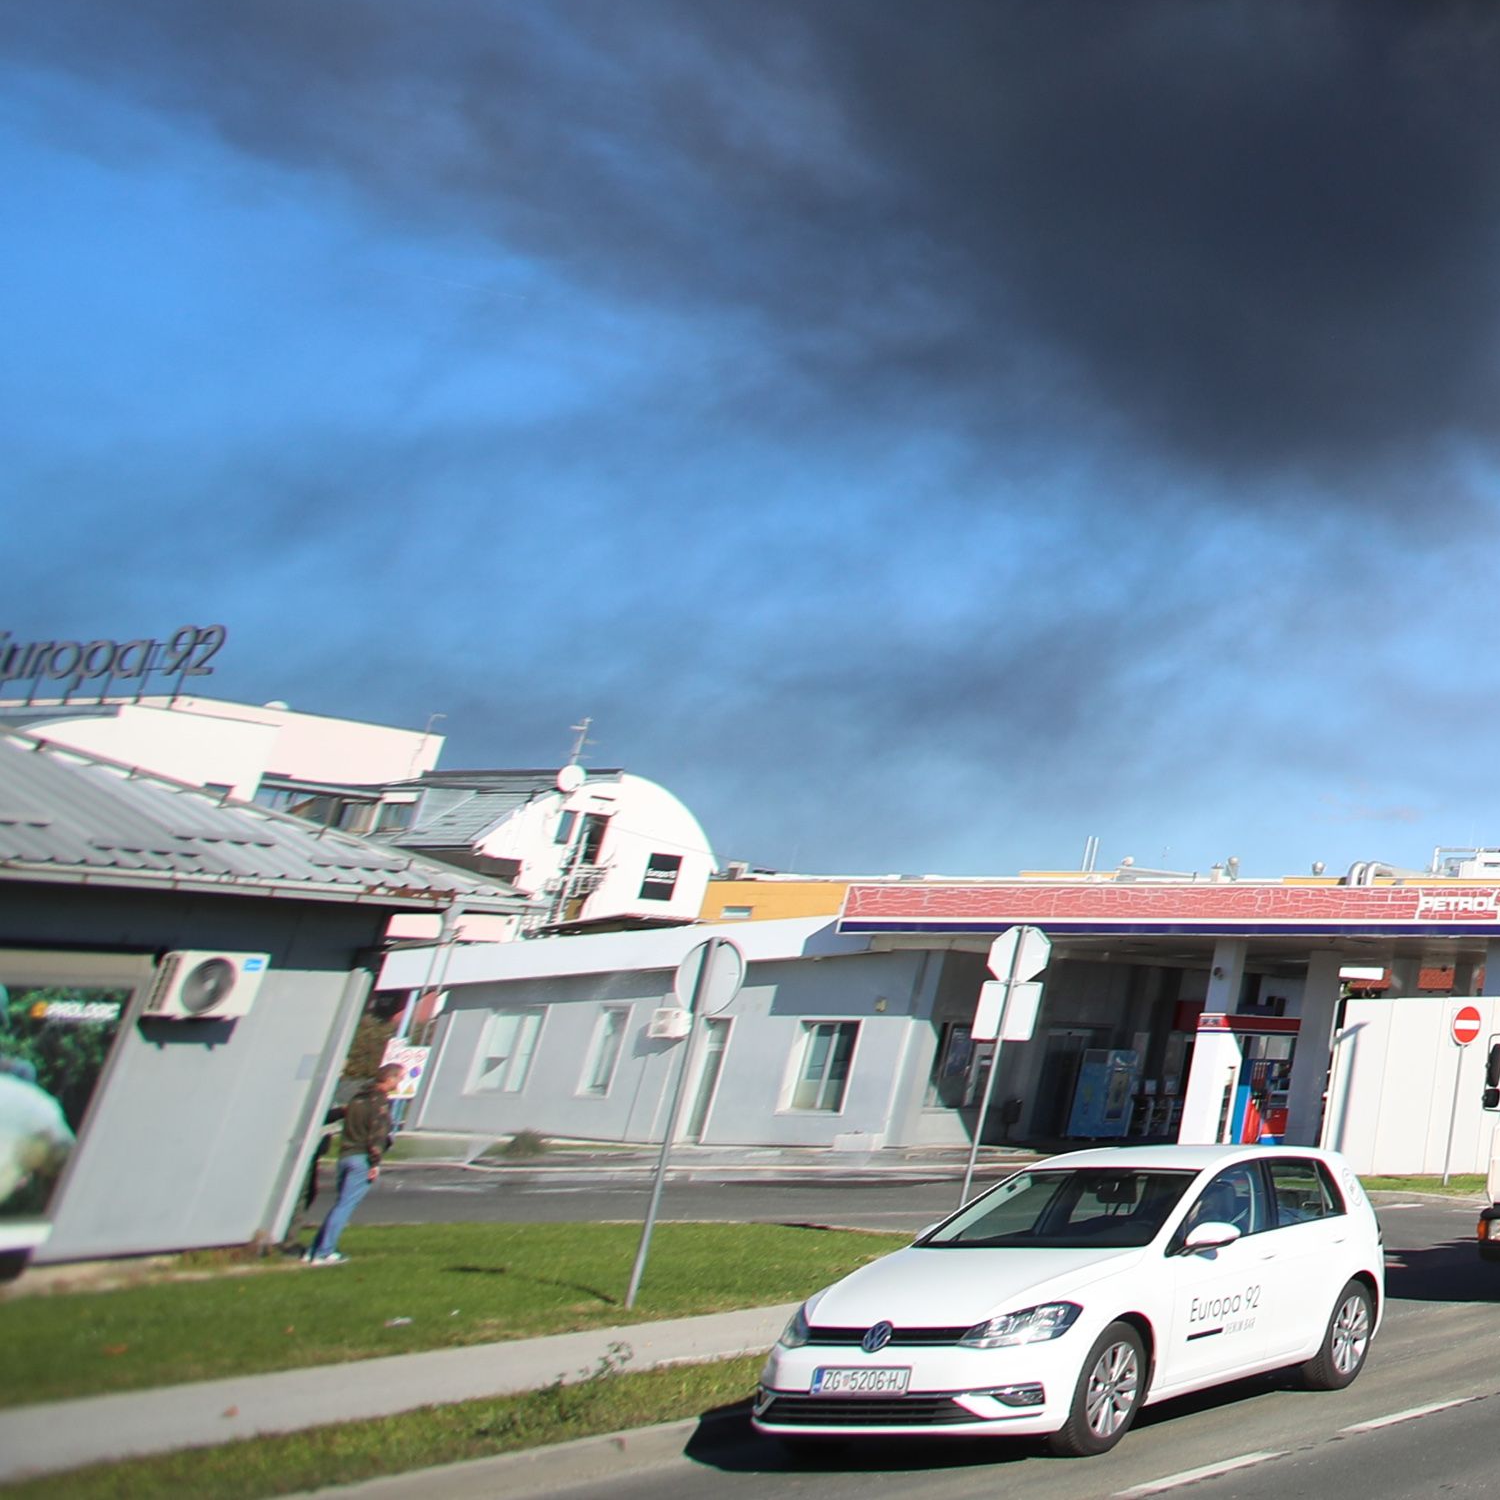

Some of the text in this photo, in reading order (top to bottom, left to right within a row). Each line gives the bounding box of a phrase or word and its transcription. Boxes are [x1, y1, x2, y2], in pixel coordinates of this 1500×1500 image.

[163, 625, 226, 676] 92
[1418, 896, 1500, 912] PETROL
[1189, 1284, 1261, 1323] Europa 92
[823, 1371, 841, 1390] ZG
